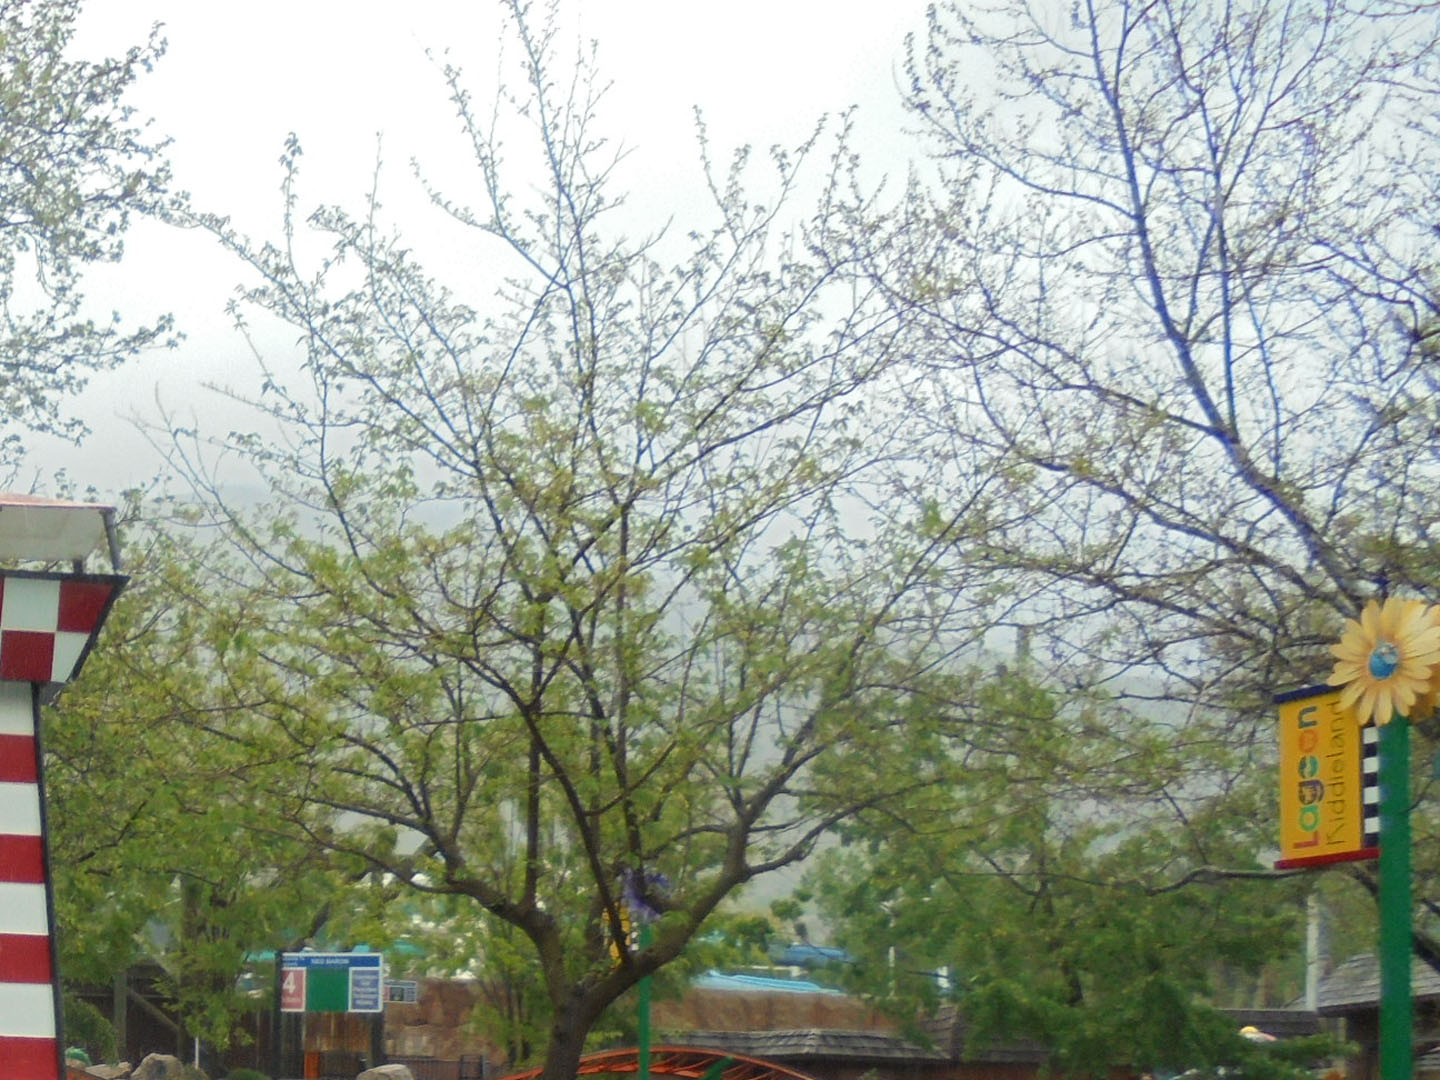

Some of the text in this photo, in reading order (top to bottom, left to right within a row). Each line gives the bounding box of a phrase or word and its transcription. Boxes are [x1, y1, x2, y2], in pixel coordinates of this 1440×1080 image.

[1293, 705, 1325, 849] Lagoon
[1326, 700, 1346, 845] Kiddieland
[282, 971, 296, 994] 4
